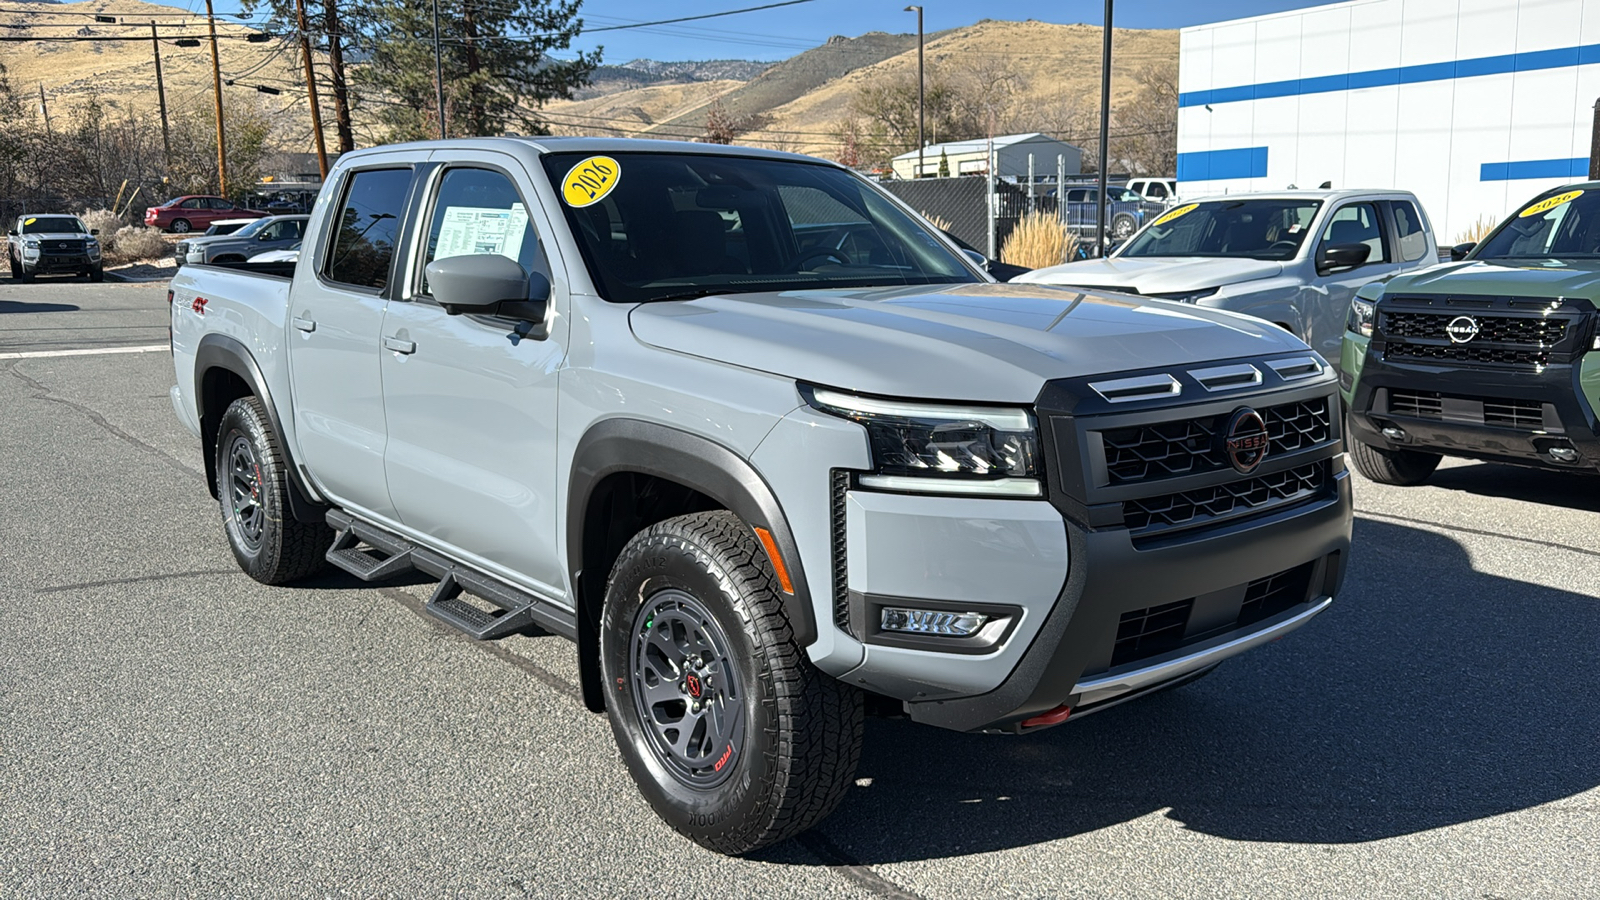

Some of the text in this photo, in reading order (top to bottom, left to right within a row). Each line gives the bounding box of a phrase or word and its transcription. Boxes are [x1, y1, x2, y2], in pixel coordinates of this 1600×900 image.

[572, 160, 612, 199] 2026
[1531, 194, 1571, 213] 2026
[1227, 437, 1266, 449] NISSA
